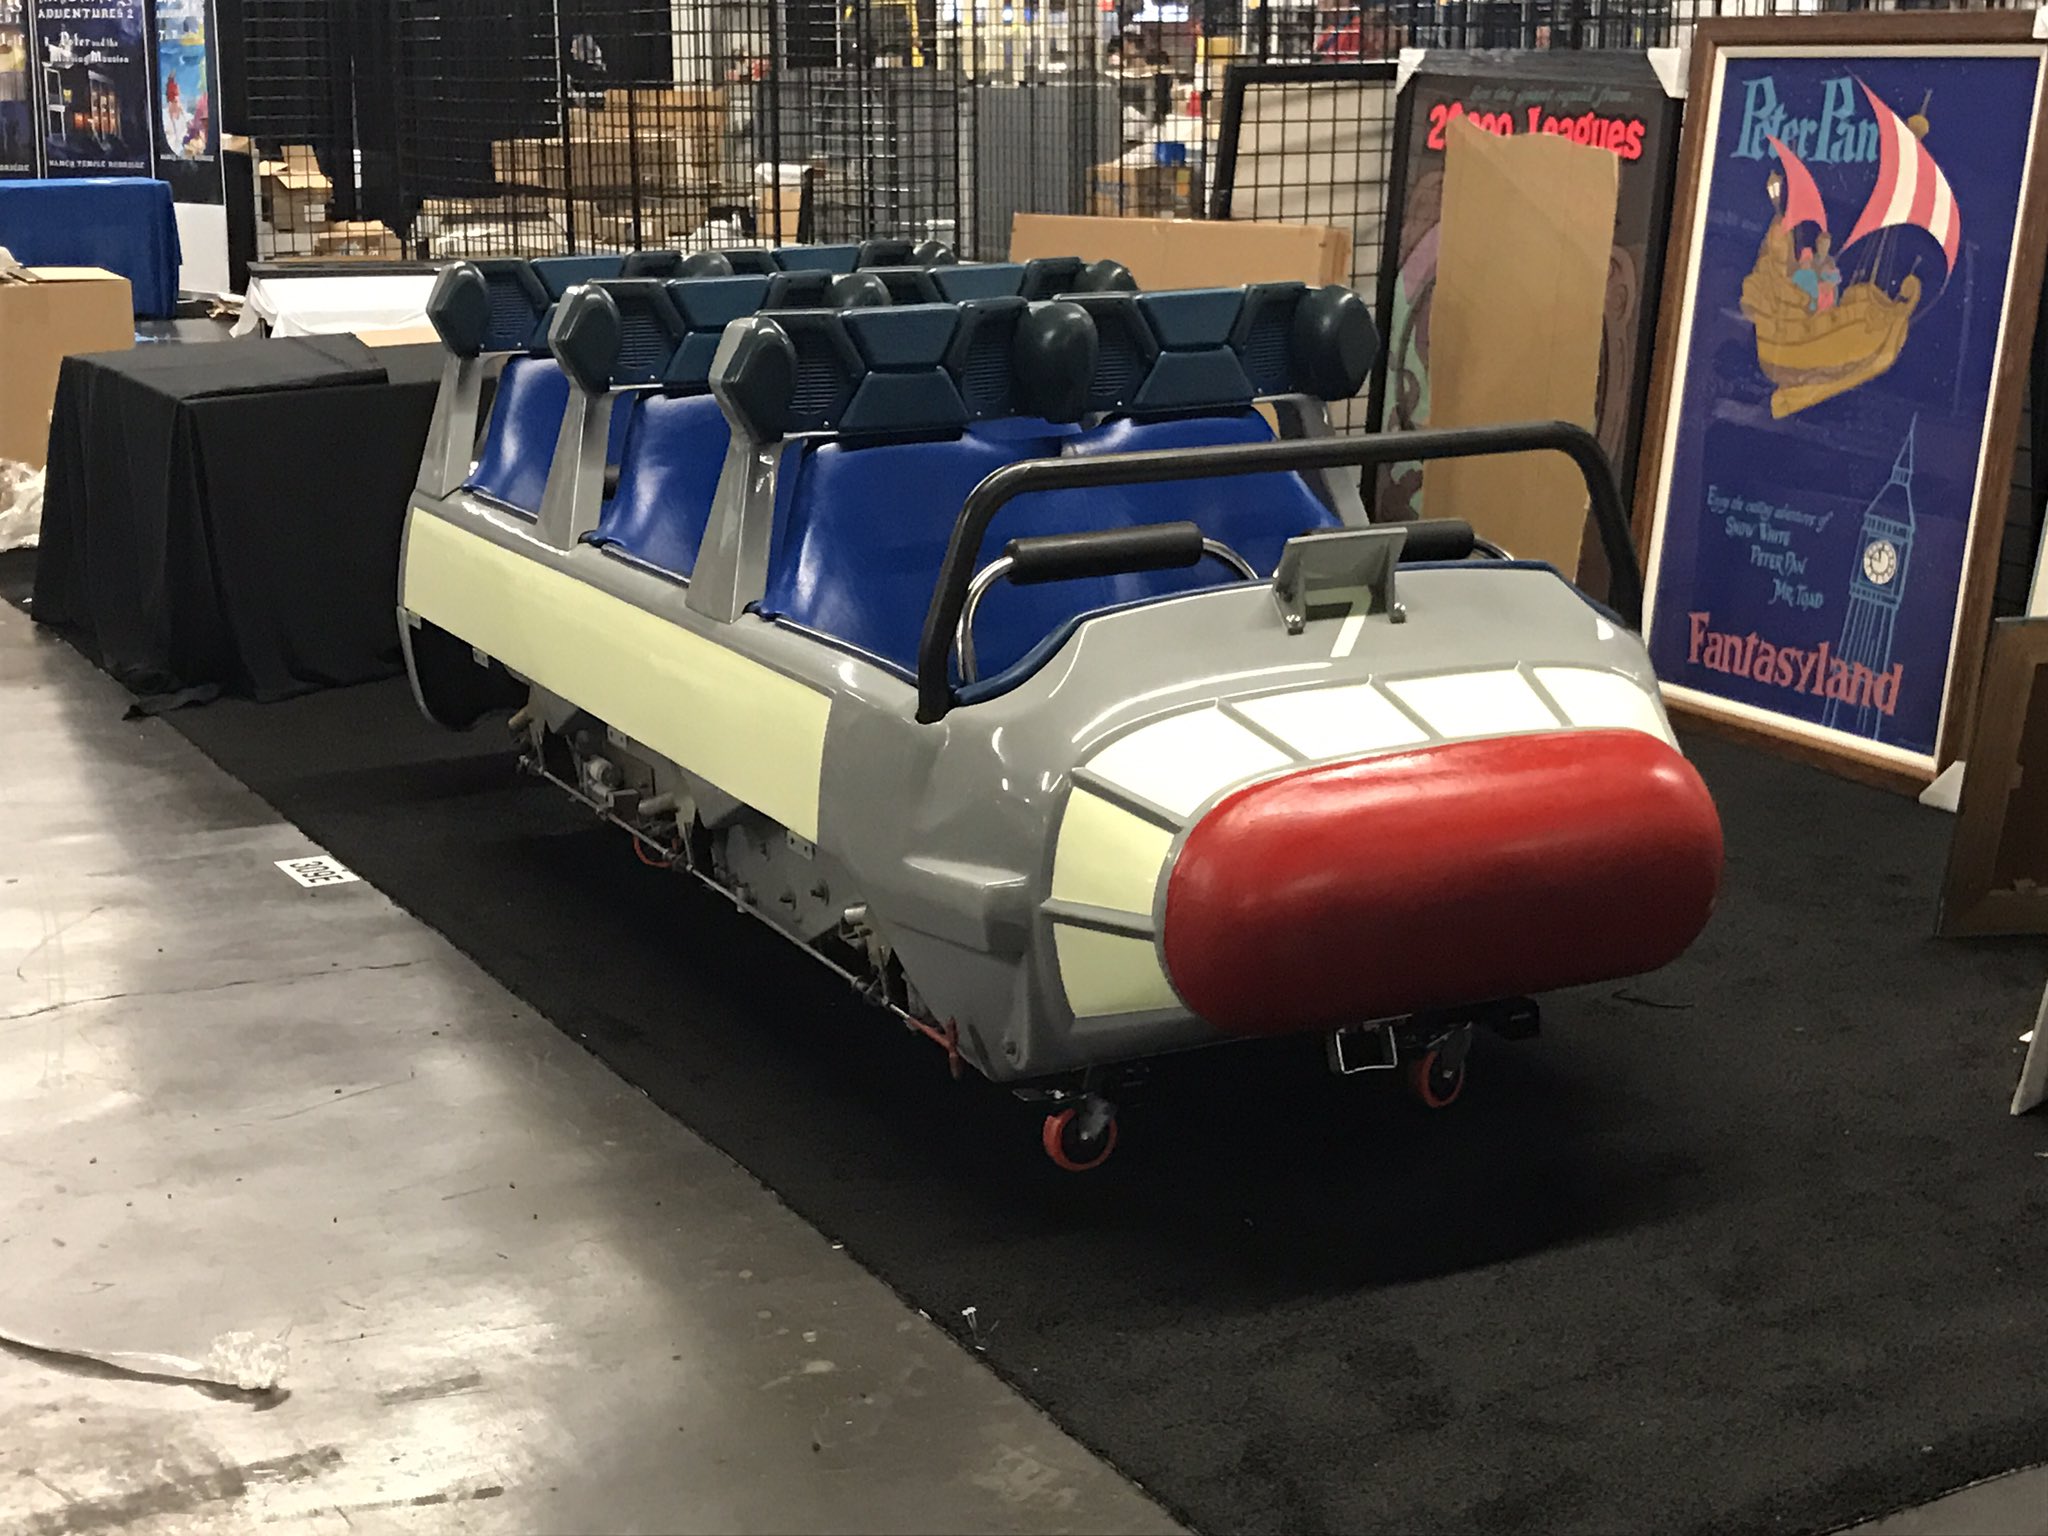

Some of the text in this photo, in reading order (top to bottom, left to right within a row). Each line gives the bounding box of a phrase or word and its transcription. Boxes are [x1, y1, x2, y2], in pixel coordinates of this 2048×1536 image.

[38, 8, 134, 19] ADVENTURES 2
[1730, 76, 1880, 164] Peter Pan
[1687, 611, 1904, 716] Fantasyland
